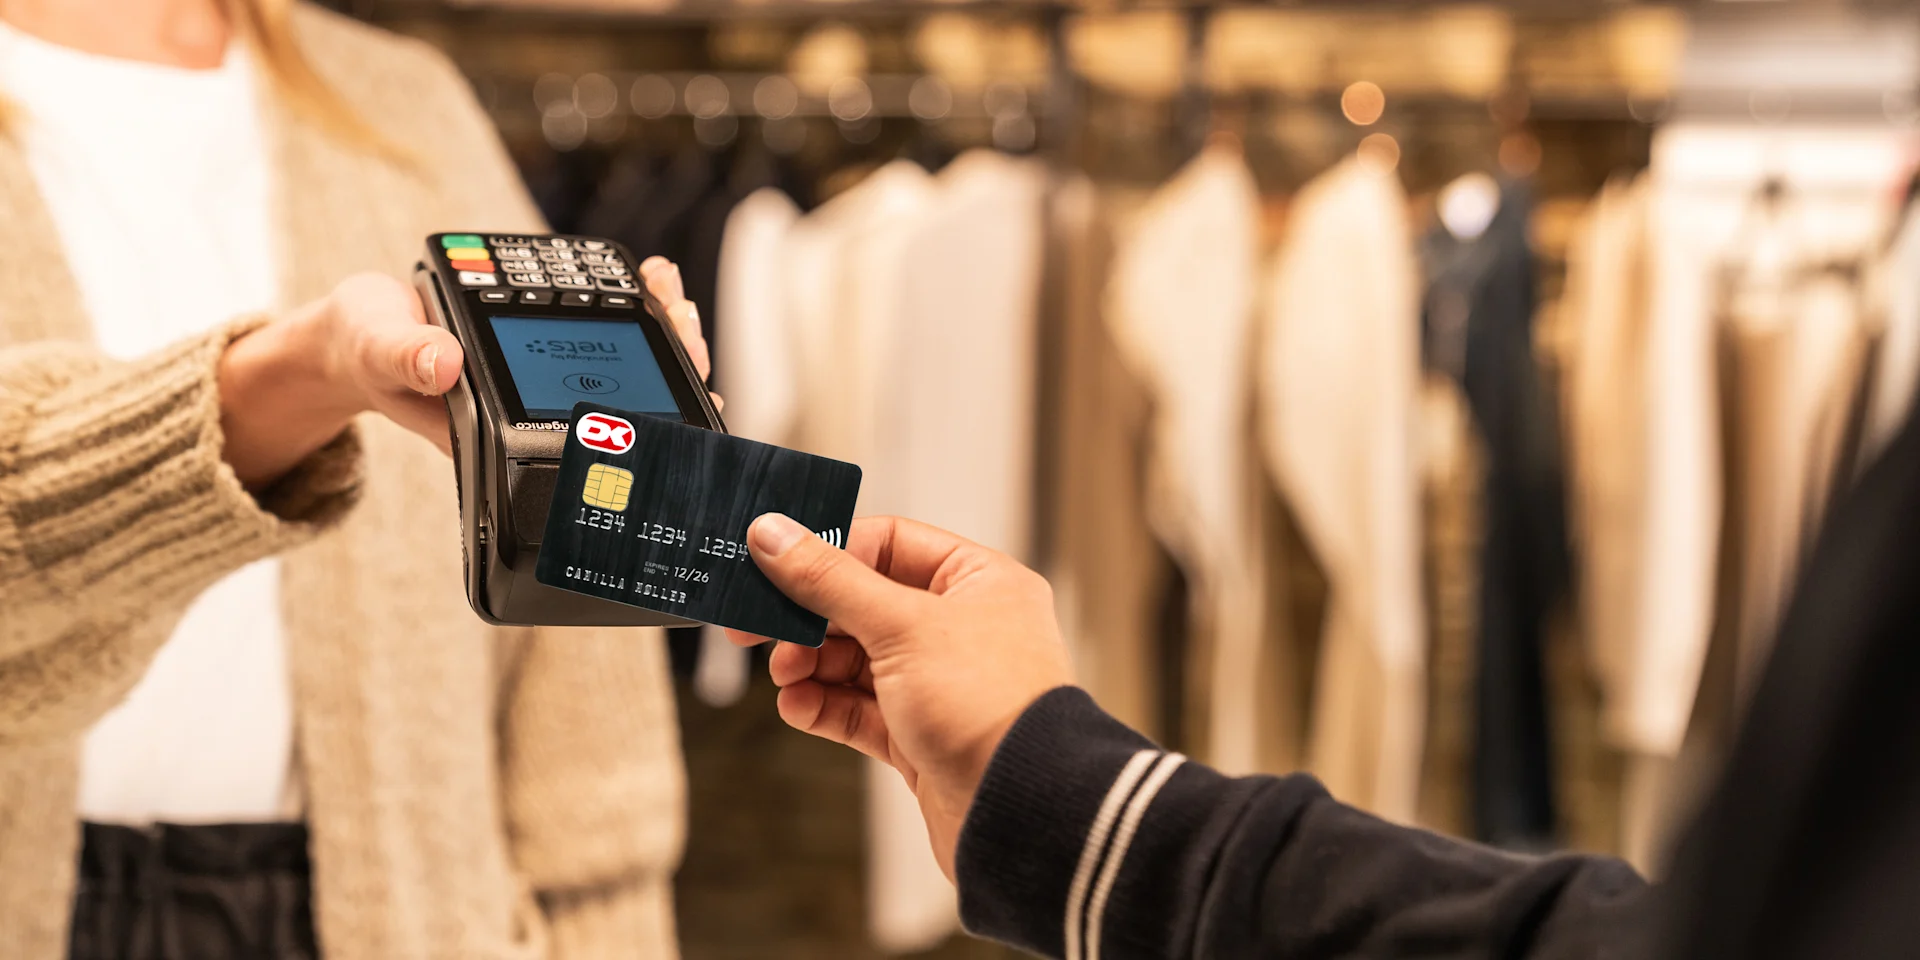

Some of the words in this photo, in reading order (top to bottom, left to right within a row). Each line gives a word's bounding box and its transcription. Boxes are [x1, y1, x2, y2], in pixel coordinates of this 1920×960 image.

[547, 340, 618, 354] nets
[515, 420, 569, 430] ngenico
[576, 415, 632, 449] DK
[575, 507, 626, 533] 1234
[637, 522, 687, 547] 1234
[699, 536, 749, 561] 1234
[674, 566, 710, 583] 12/26
